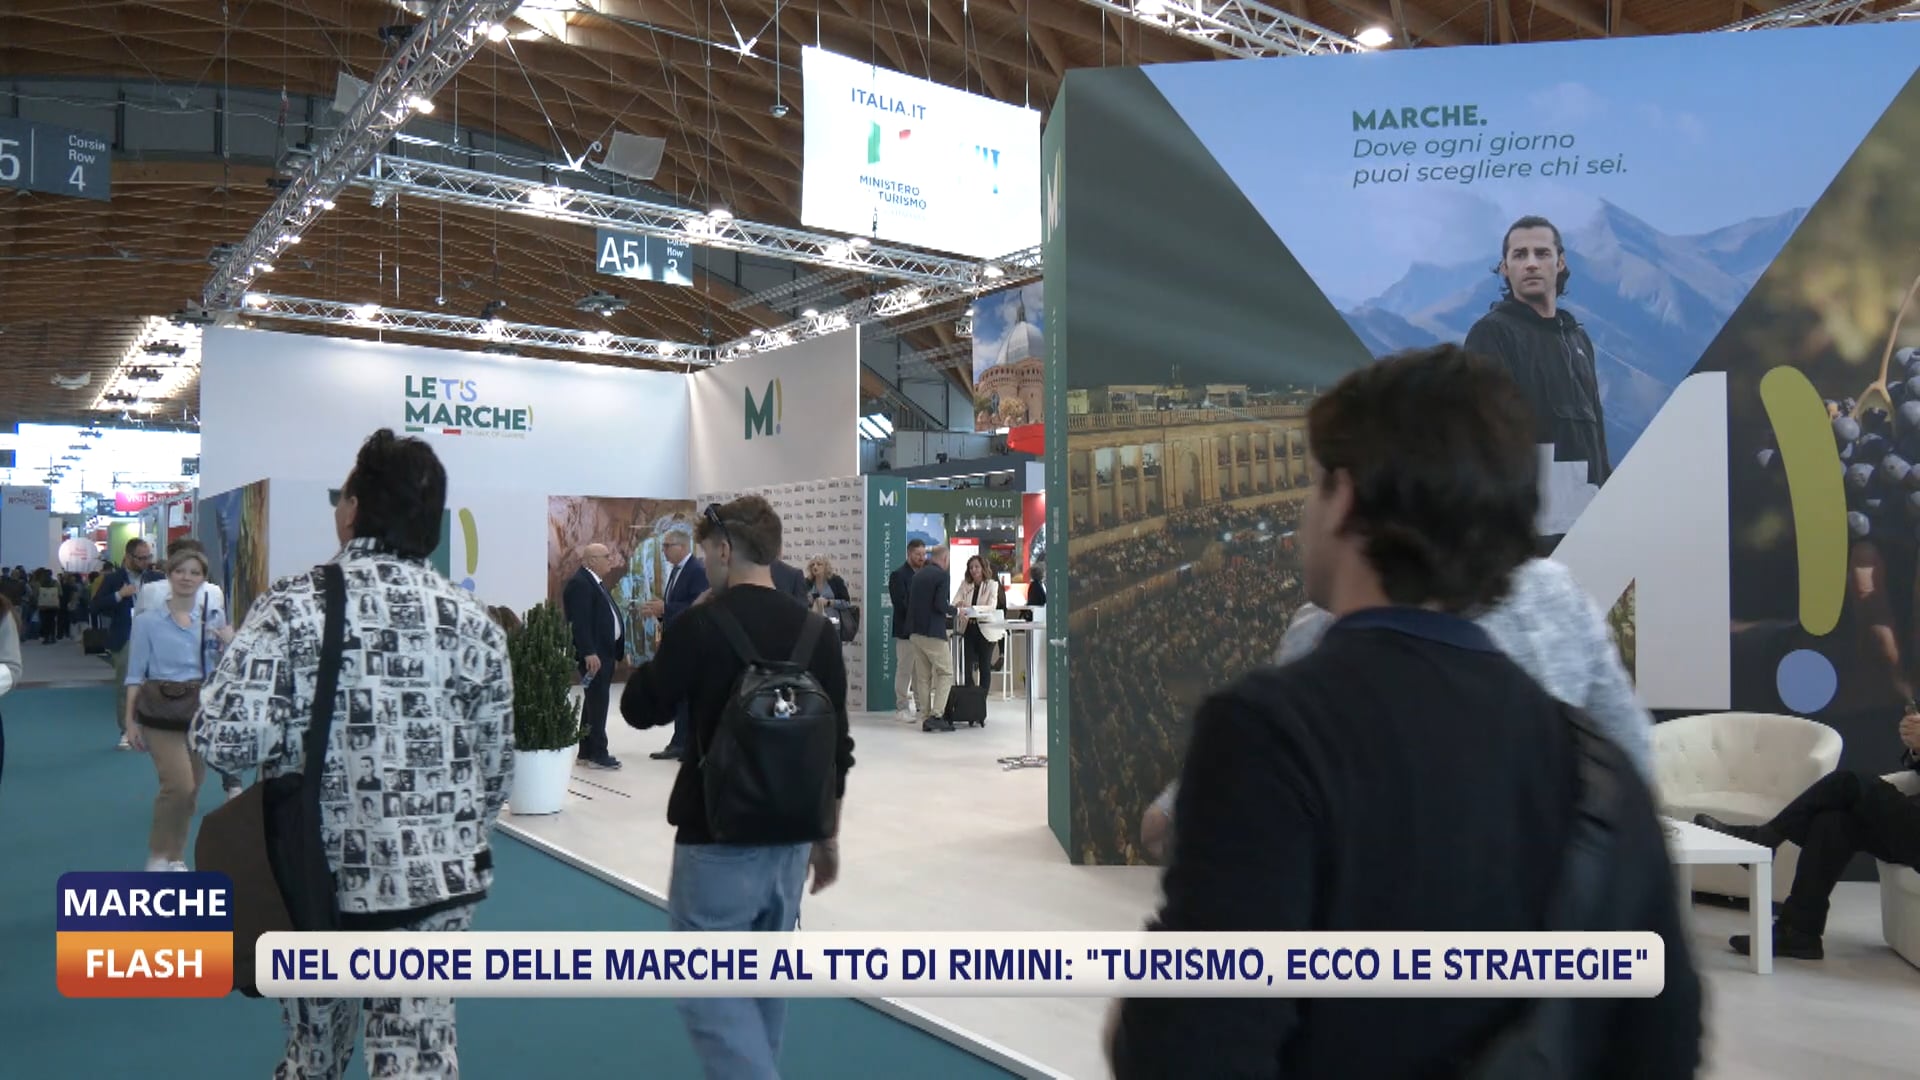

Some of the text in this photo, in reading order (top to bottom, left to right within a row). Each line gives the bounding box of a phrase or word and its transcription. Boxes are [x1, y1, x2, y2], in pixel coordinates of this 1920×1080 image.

[852, 88, 926, 120] ITALIA.IT
[1352, 105, 1487, 131] MARCHE.
[68, 149, 95, 164] Row
[1353, 131, 1574, 158] Dove ogni giorno
[68, 165, 86, 192] 4
[1353, 153, 1627, 188] puoi scegliere chi sei.
[859, 174, 920, 196] MINISTERO
[879, 191, 927, 210] TURISMO
[599, 236, 640, 272] A5
[405, 375, 477, 402] LET'S
[405, 400, 533, 432] MARCHE!
[745, 377, 783, 440] M!
